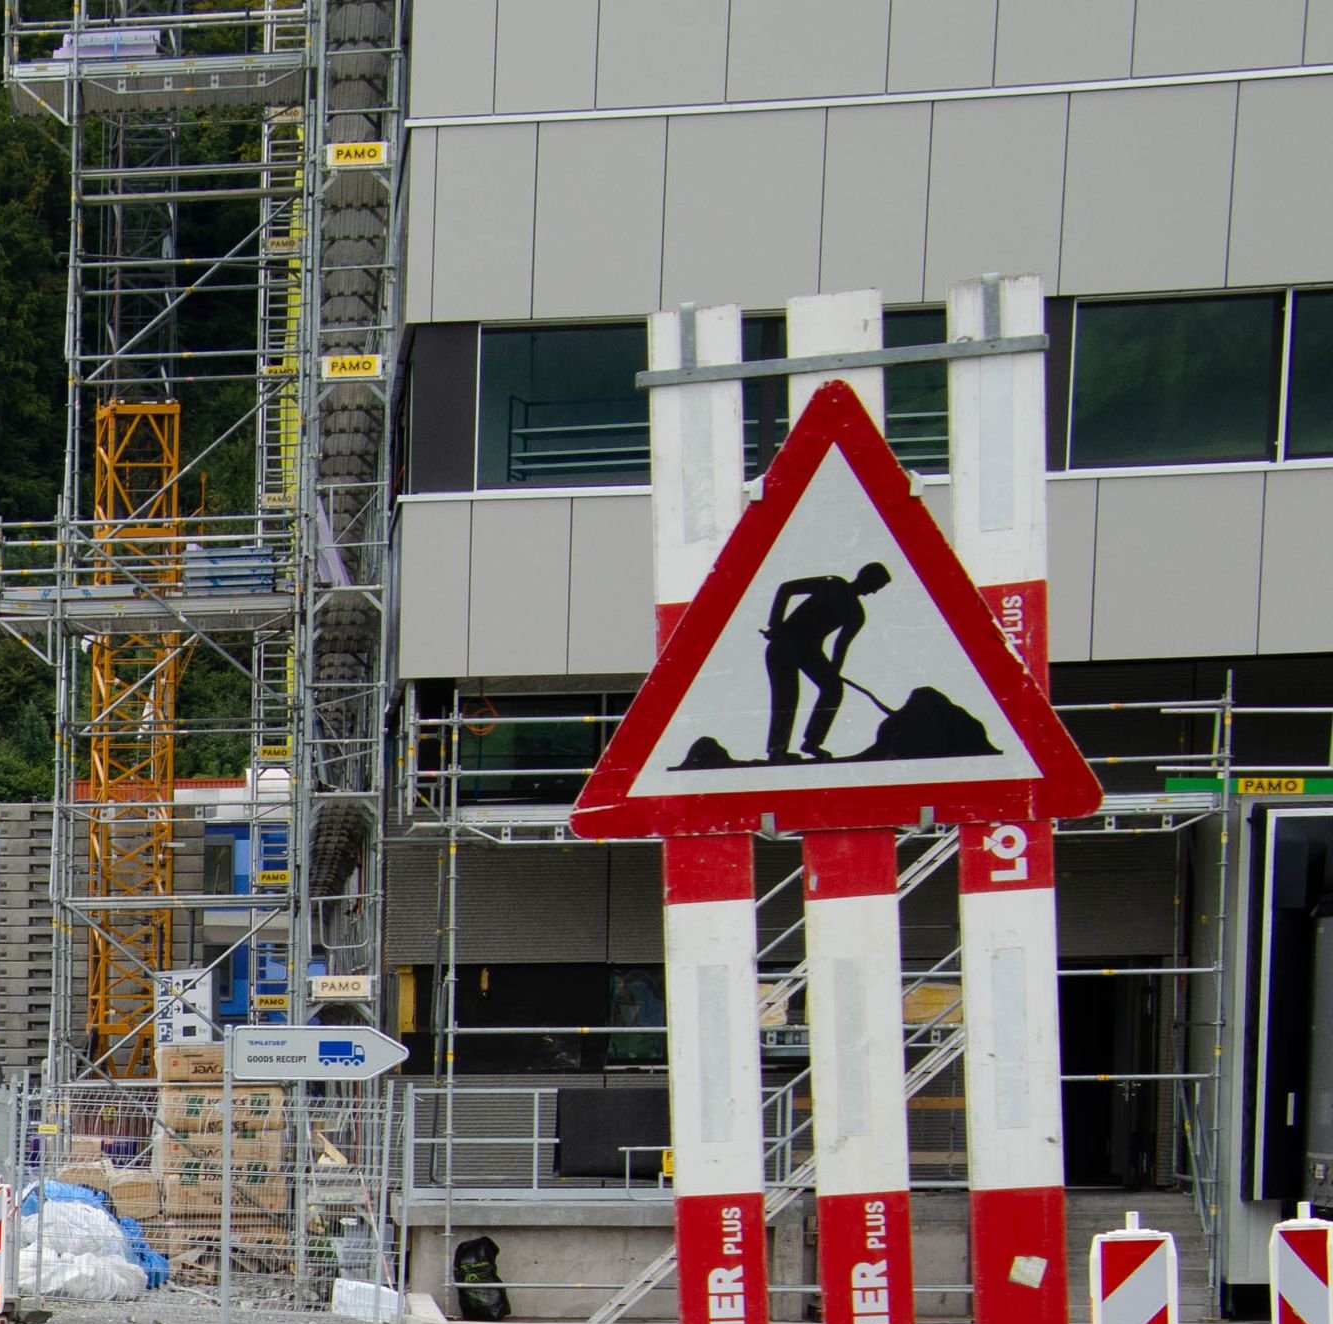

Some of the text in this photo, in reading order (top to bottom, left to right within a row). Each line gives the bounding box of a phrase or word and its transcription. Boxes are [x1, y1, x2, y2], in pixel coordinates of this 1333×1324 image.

[336, 149, 378, 159] PAMO
[331, 361, 372, 372] PAMO
[1244, 780, 1297, 791] PAMO
[321, 981, 361, 991] PAMO
[246, 1055, 307, 1063] GOODS RECEIPT
[865, 1200, 887, 1249] PLUS
[722, 1206, 743, 1255] PLUS
